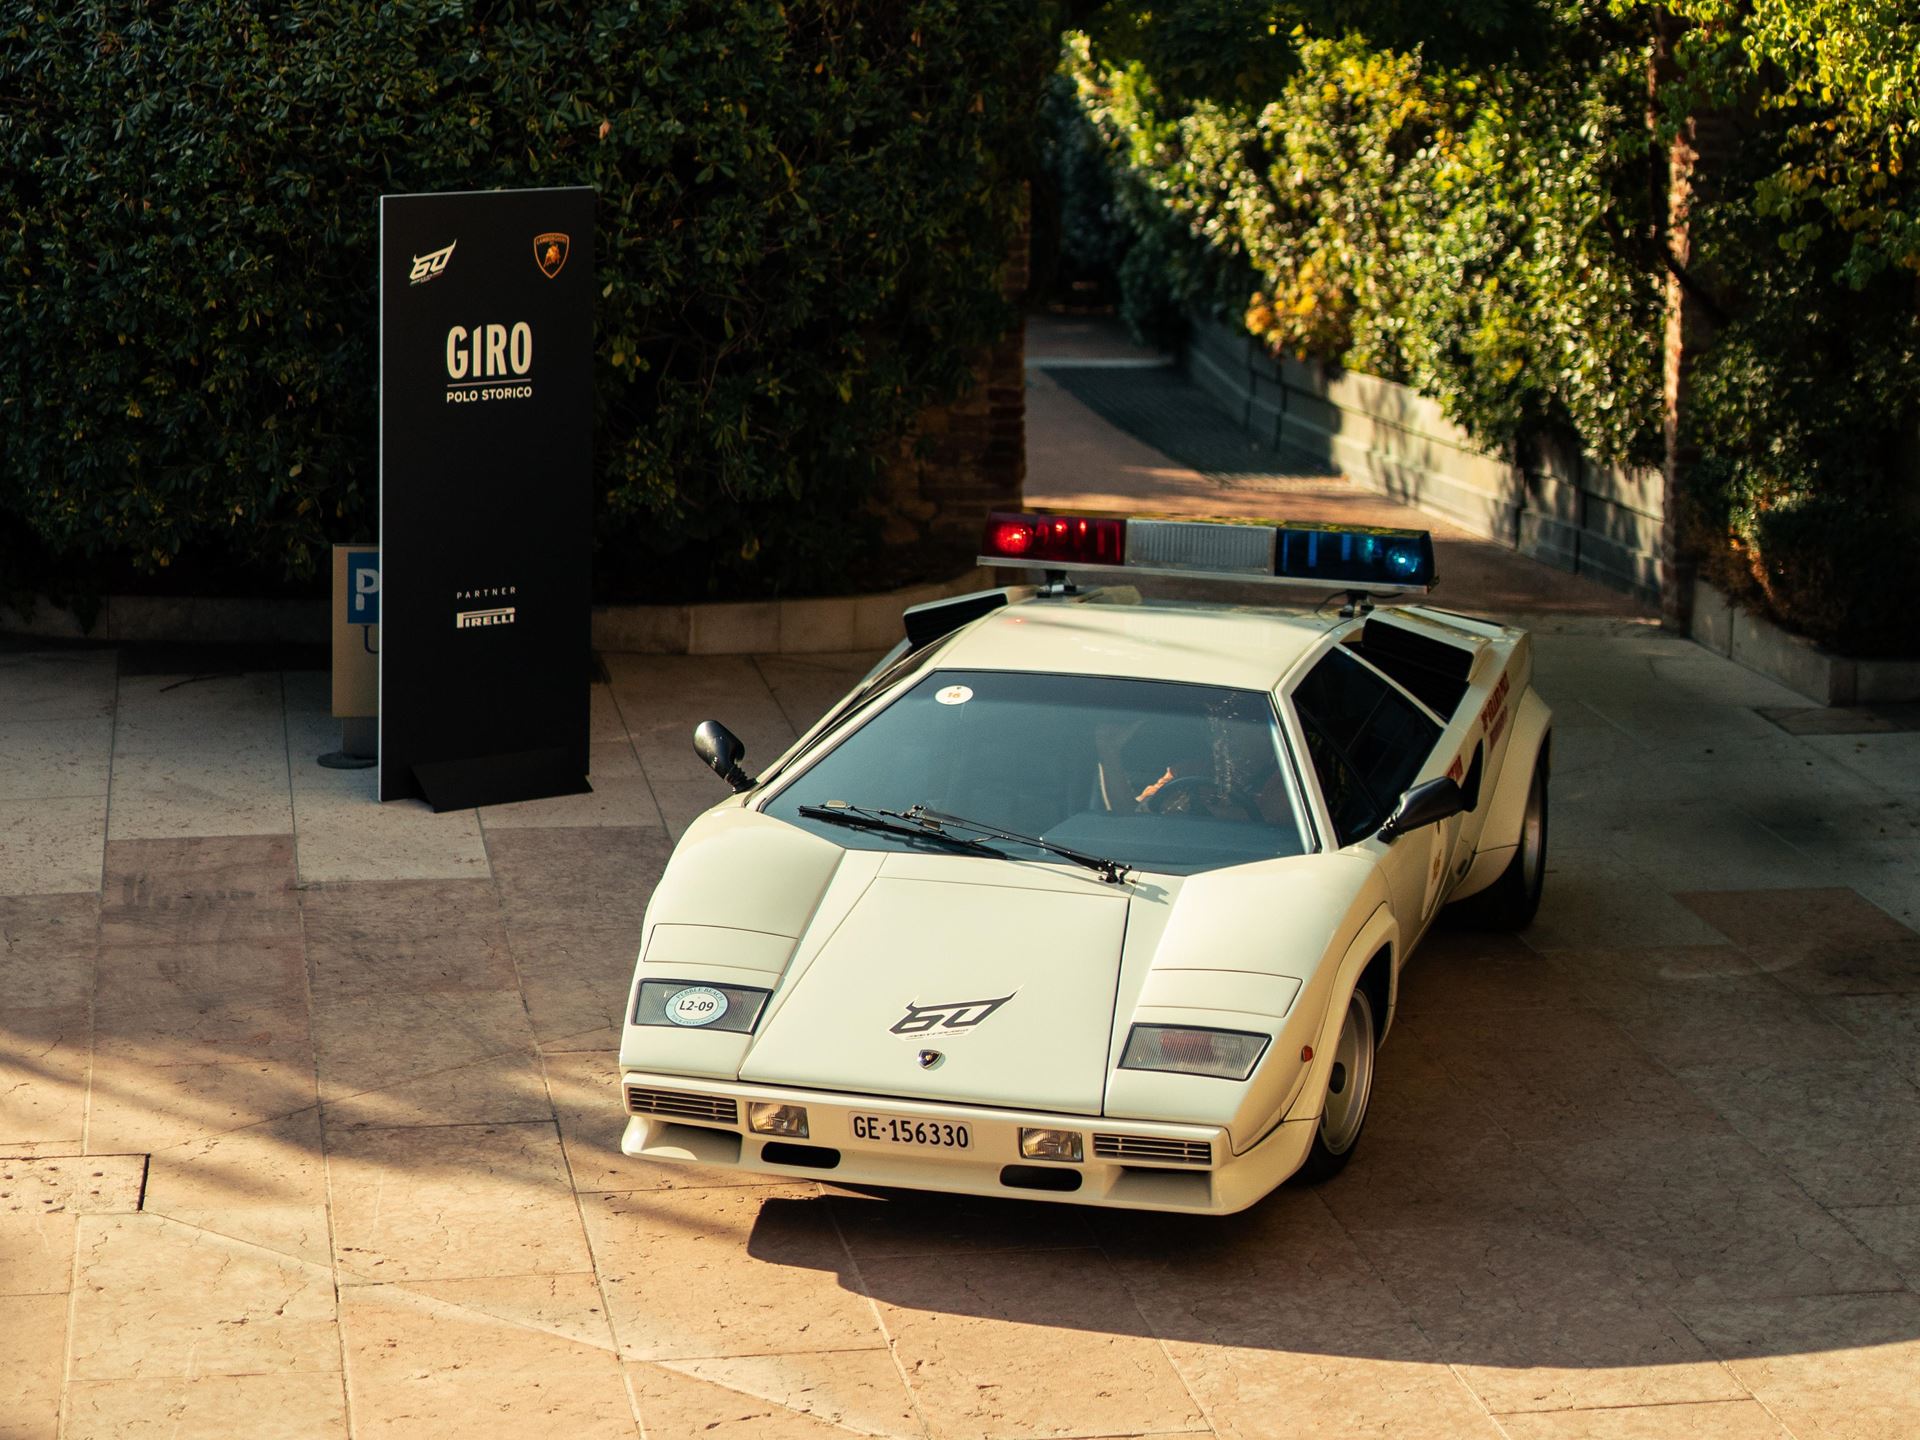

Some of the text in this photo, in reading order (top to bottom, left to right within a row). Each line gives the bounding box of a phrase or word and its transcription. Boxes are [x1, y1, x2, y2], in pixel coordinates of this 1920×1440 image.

[447, 321, 533, 379] GIRO
[447, 386, 532, 403] POLO STORICO
[457, 586, 516, 599] PARTNER
[457, 607, 515, 628] PIRELLI
[679, 1000, 714, 1011] L2-09
